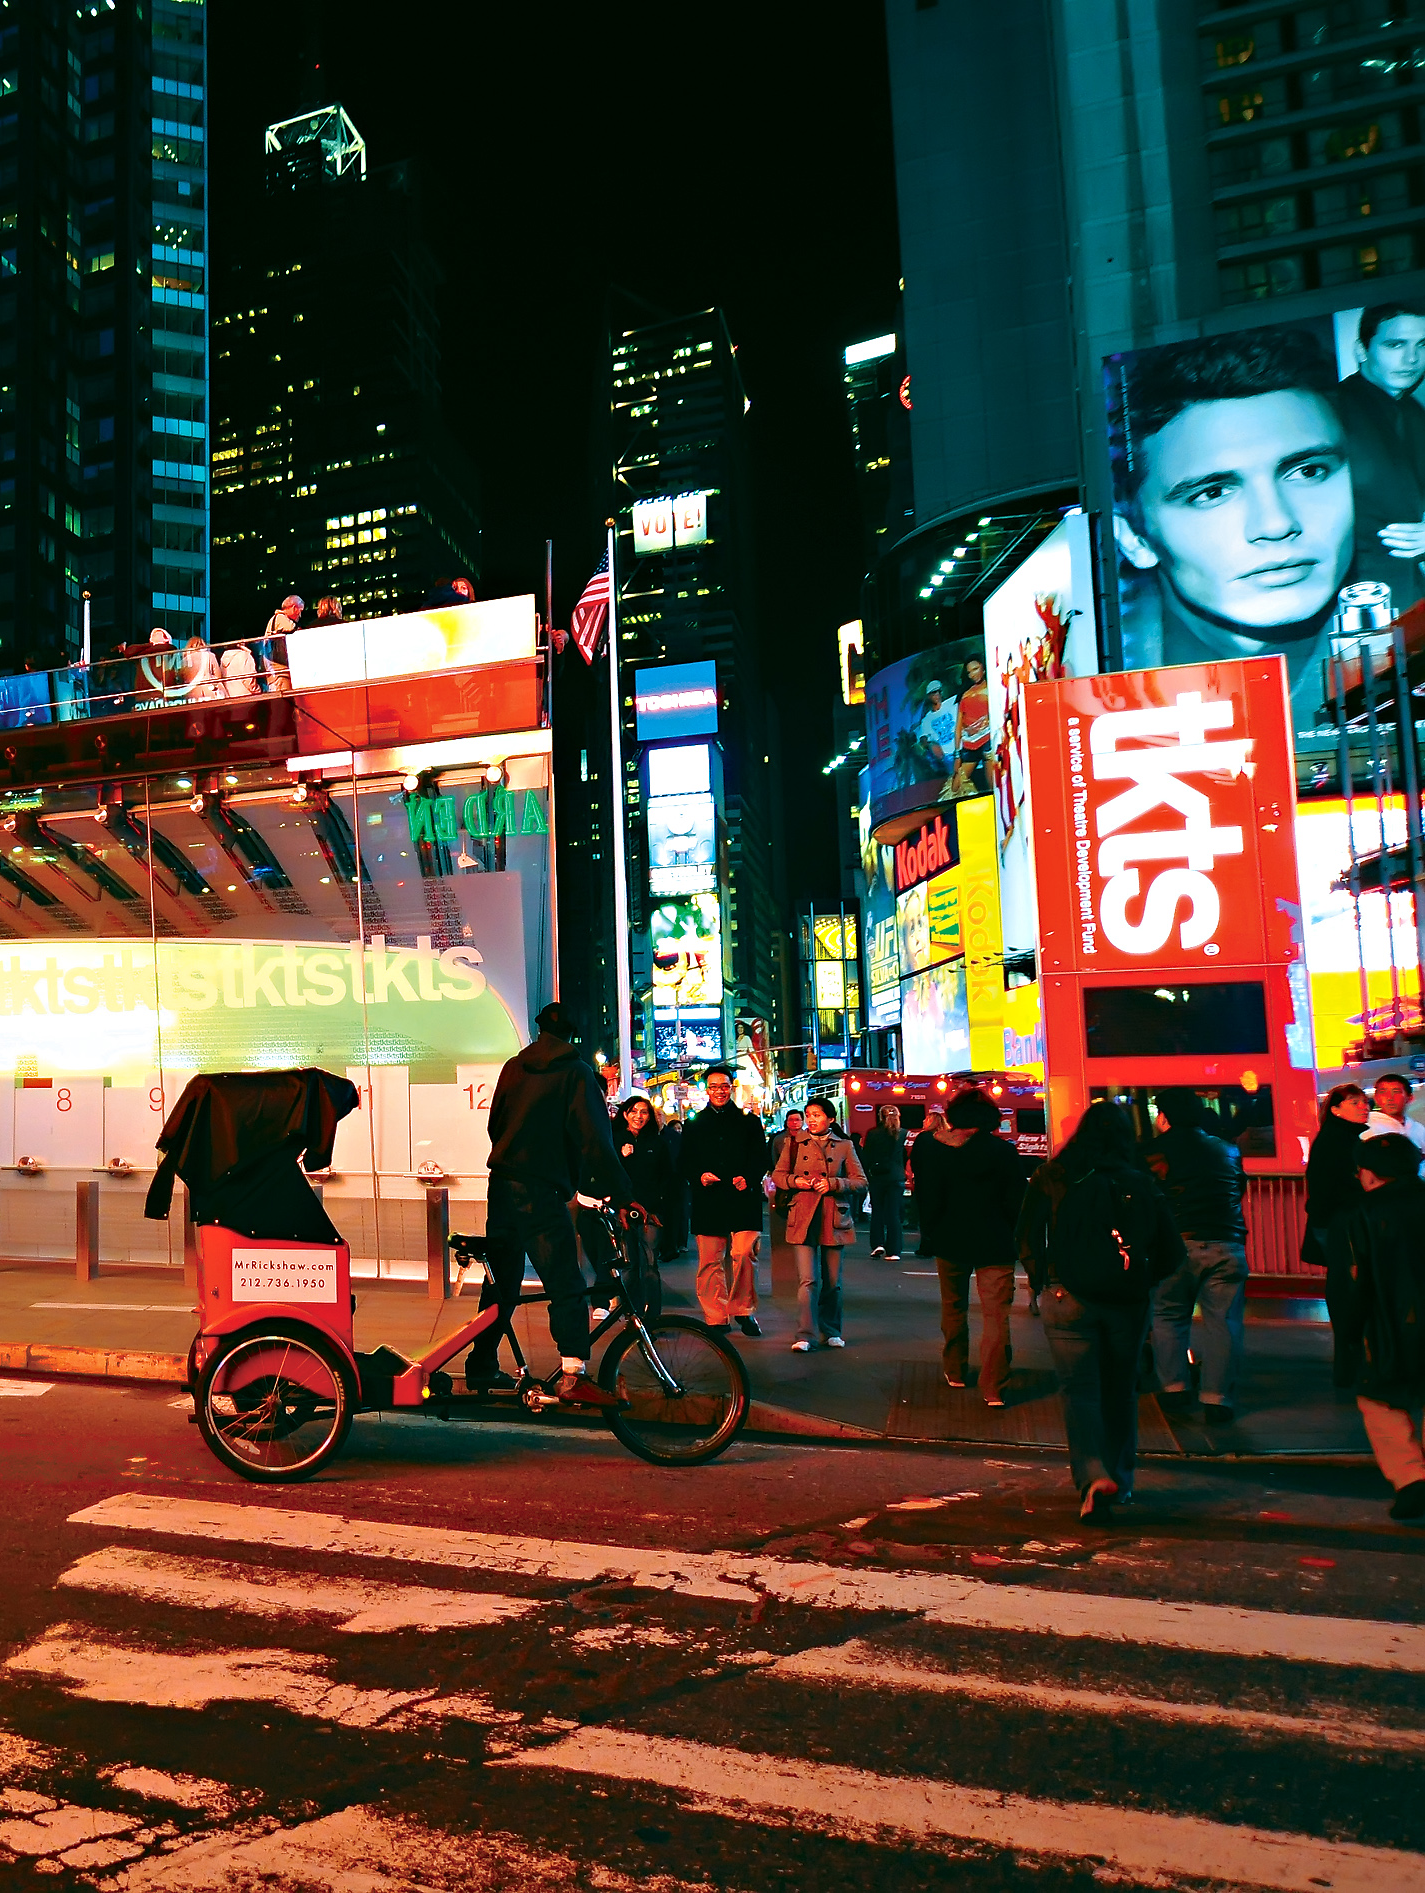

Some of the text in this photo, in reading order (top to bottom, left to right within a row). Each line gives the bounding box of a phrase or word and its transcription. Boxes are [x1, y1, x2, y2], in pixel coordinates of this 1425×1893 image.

[1068, 717, 1098, 955] a service of Theatre Development Fund
[1090, 691, 1256, 956] tkts
[896, 814, 951, 889] Kodak
[966, 873, 999, 1003] Kodak
[56, 1088, 73, 1112] 8
[149, 1087, 165, 1112] 9
[462, 1083, 491, 1109] 12
[234, 1260, 334, 1271] MrRickshaw.com
[240, 1278, 325, 1288] 212.736.1950
